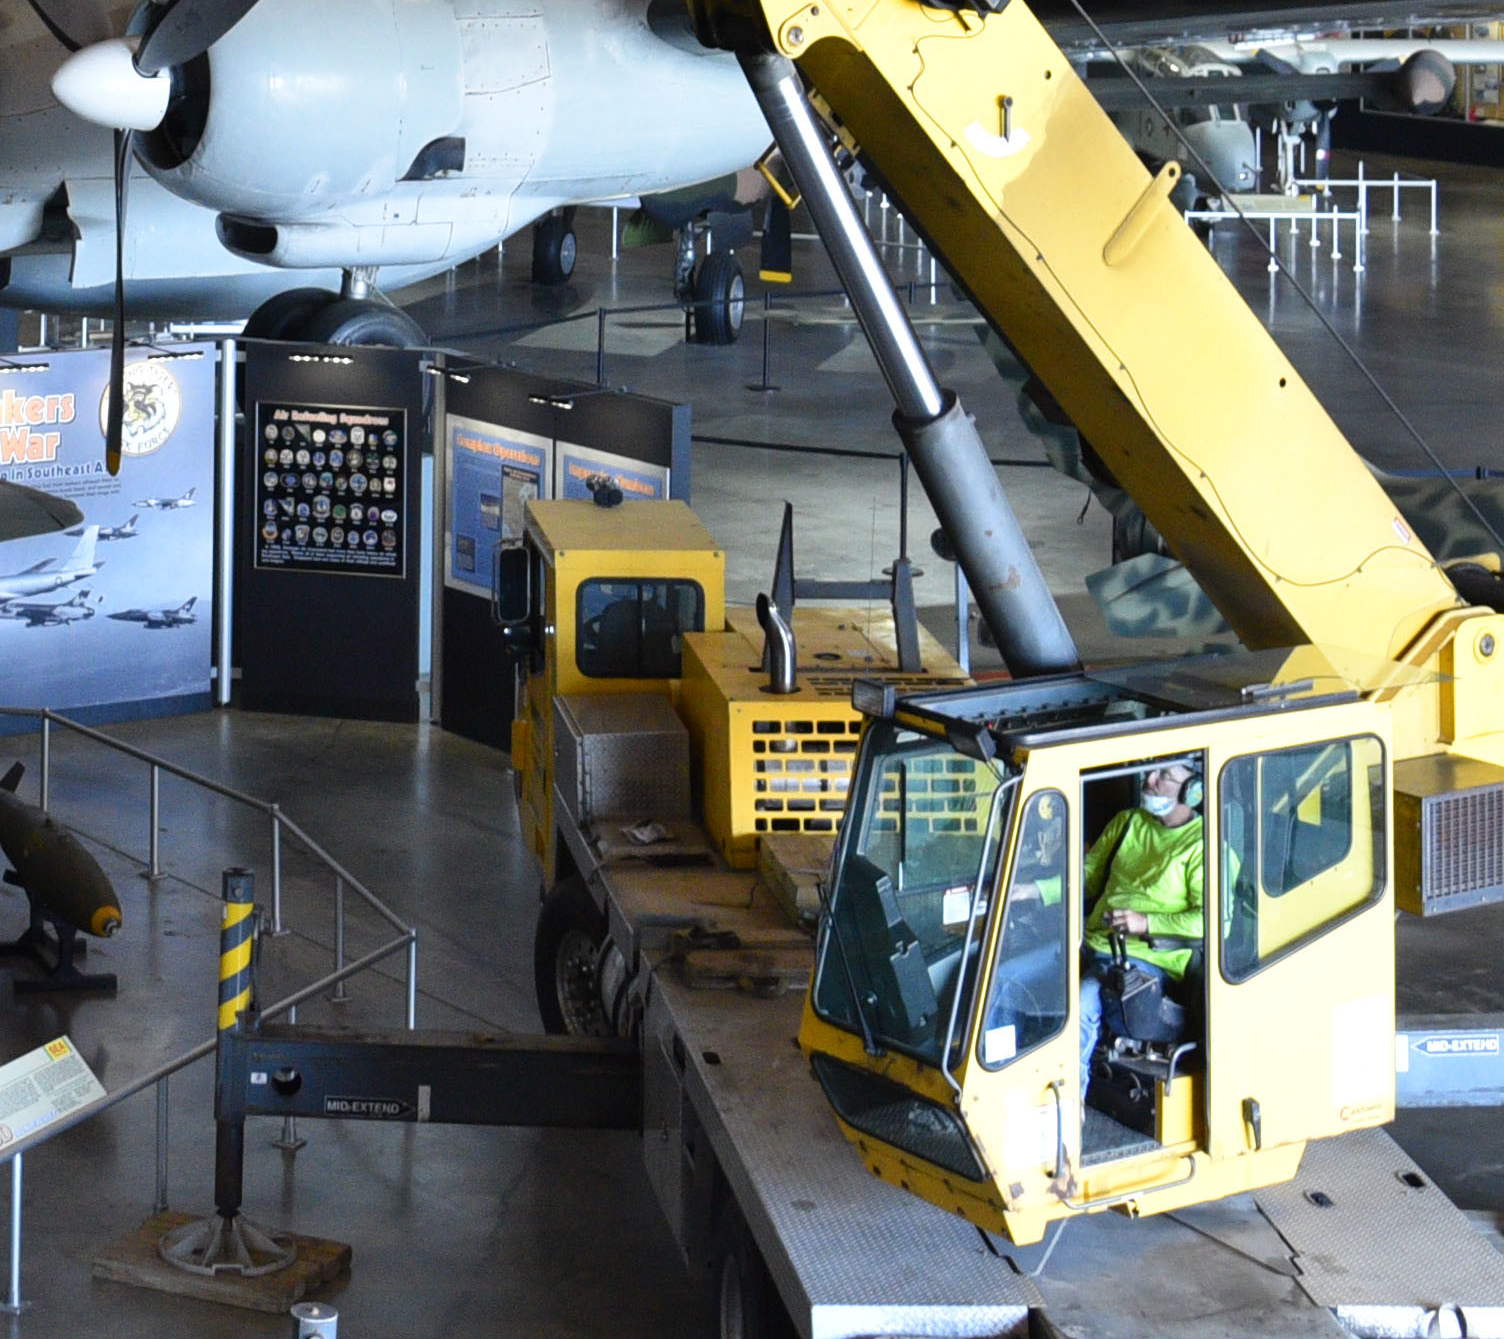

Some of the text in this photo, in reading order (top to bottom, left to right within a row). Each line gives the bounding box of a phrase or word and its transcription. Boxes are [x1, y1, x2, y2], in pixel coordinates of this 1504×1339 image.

[11, 467, 24, 480] in
[28, 463, 91, 479] Southeast
[1426, 1038, 1497, 1052] MID-EXTEND
[327, 1100, 399, 1114] MID-EXTEND
